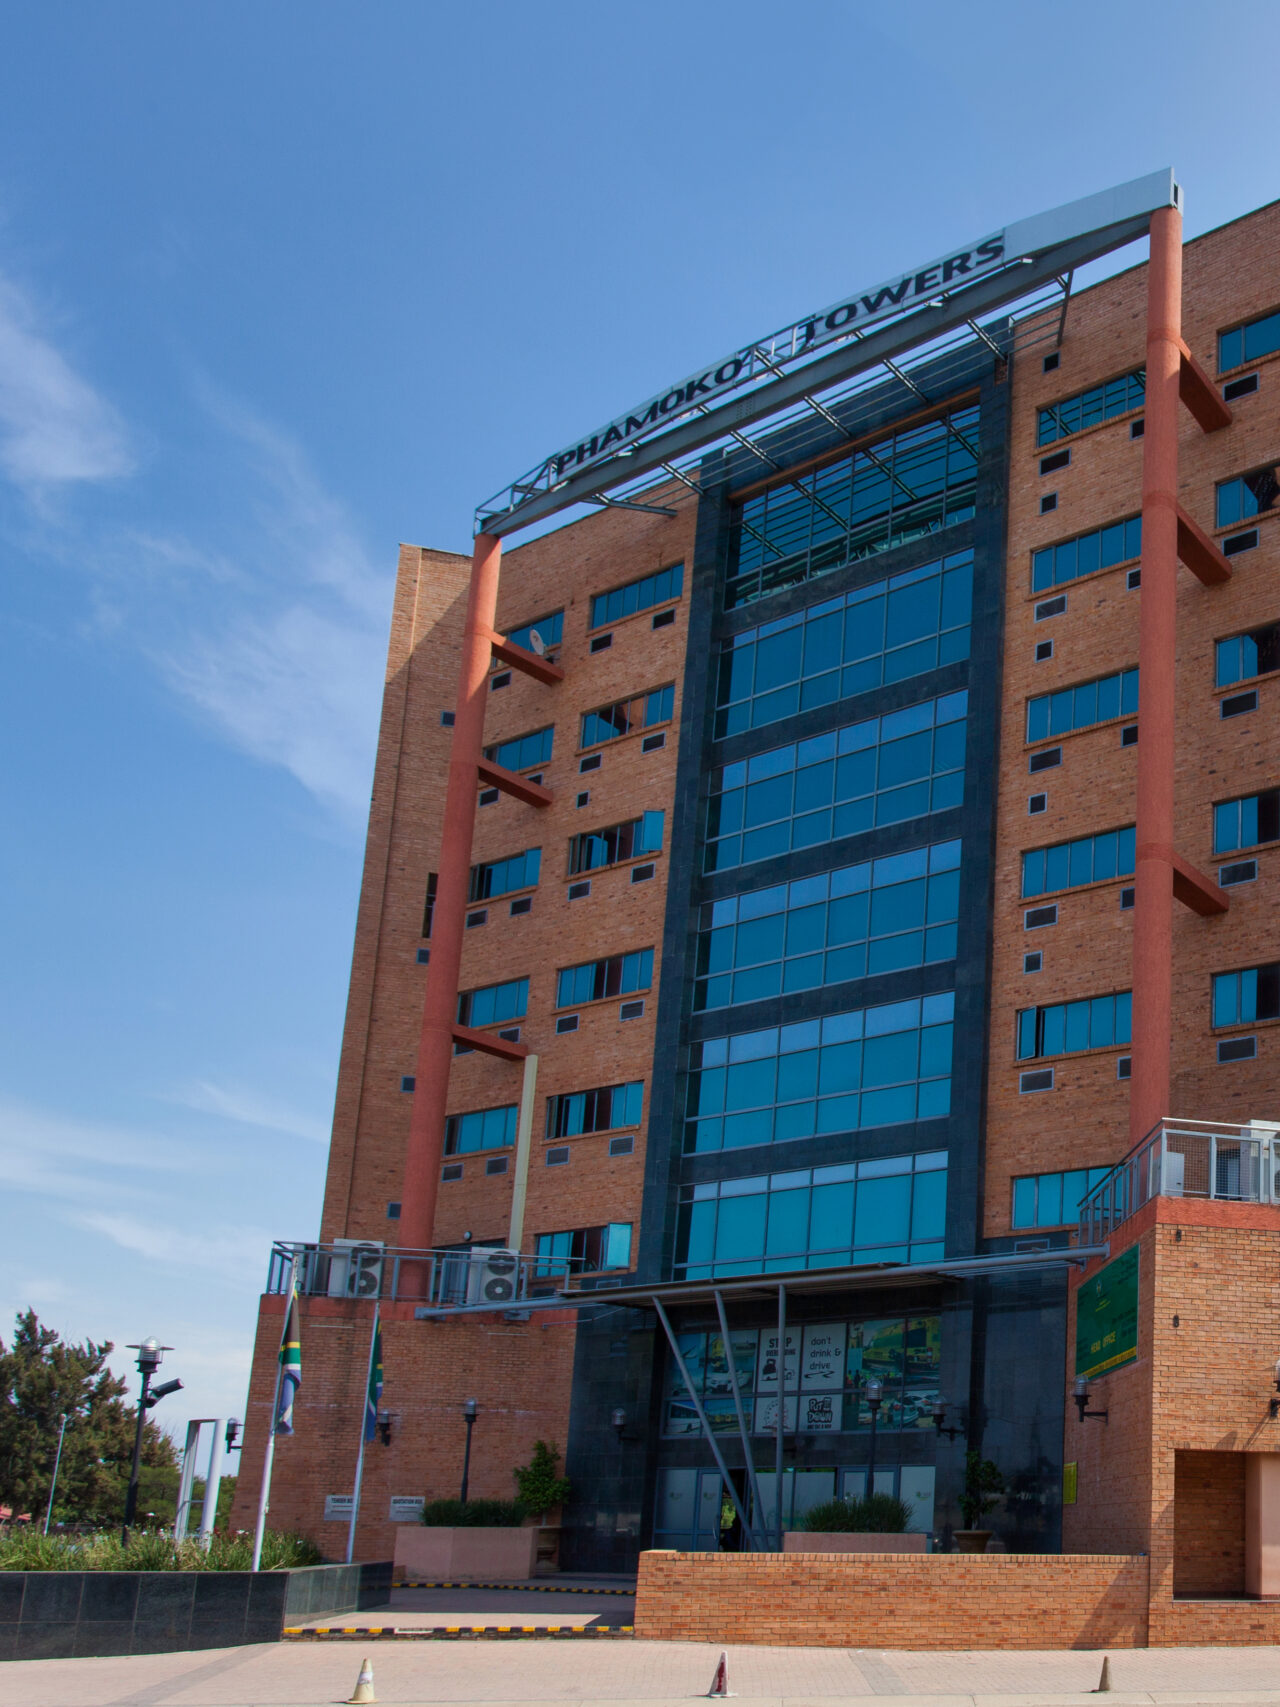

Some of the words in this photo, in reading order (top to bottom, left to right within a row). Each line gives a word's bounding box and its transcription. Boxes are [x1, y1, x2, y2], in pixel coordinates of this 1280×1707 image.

[556, 357, 744, 477] PHAMOKO
[797, 234, 1005, 346] TOWERS
[769, 1336, 792, 1349] STP
[811, 1336, 831, 1346] don't
[810, 1348, 832, 1358] drink
[834, 1347, 842, 1357] &
[809, 1361, 831, 1370] drive
